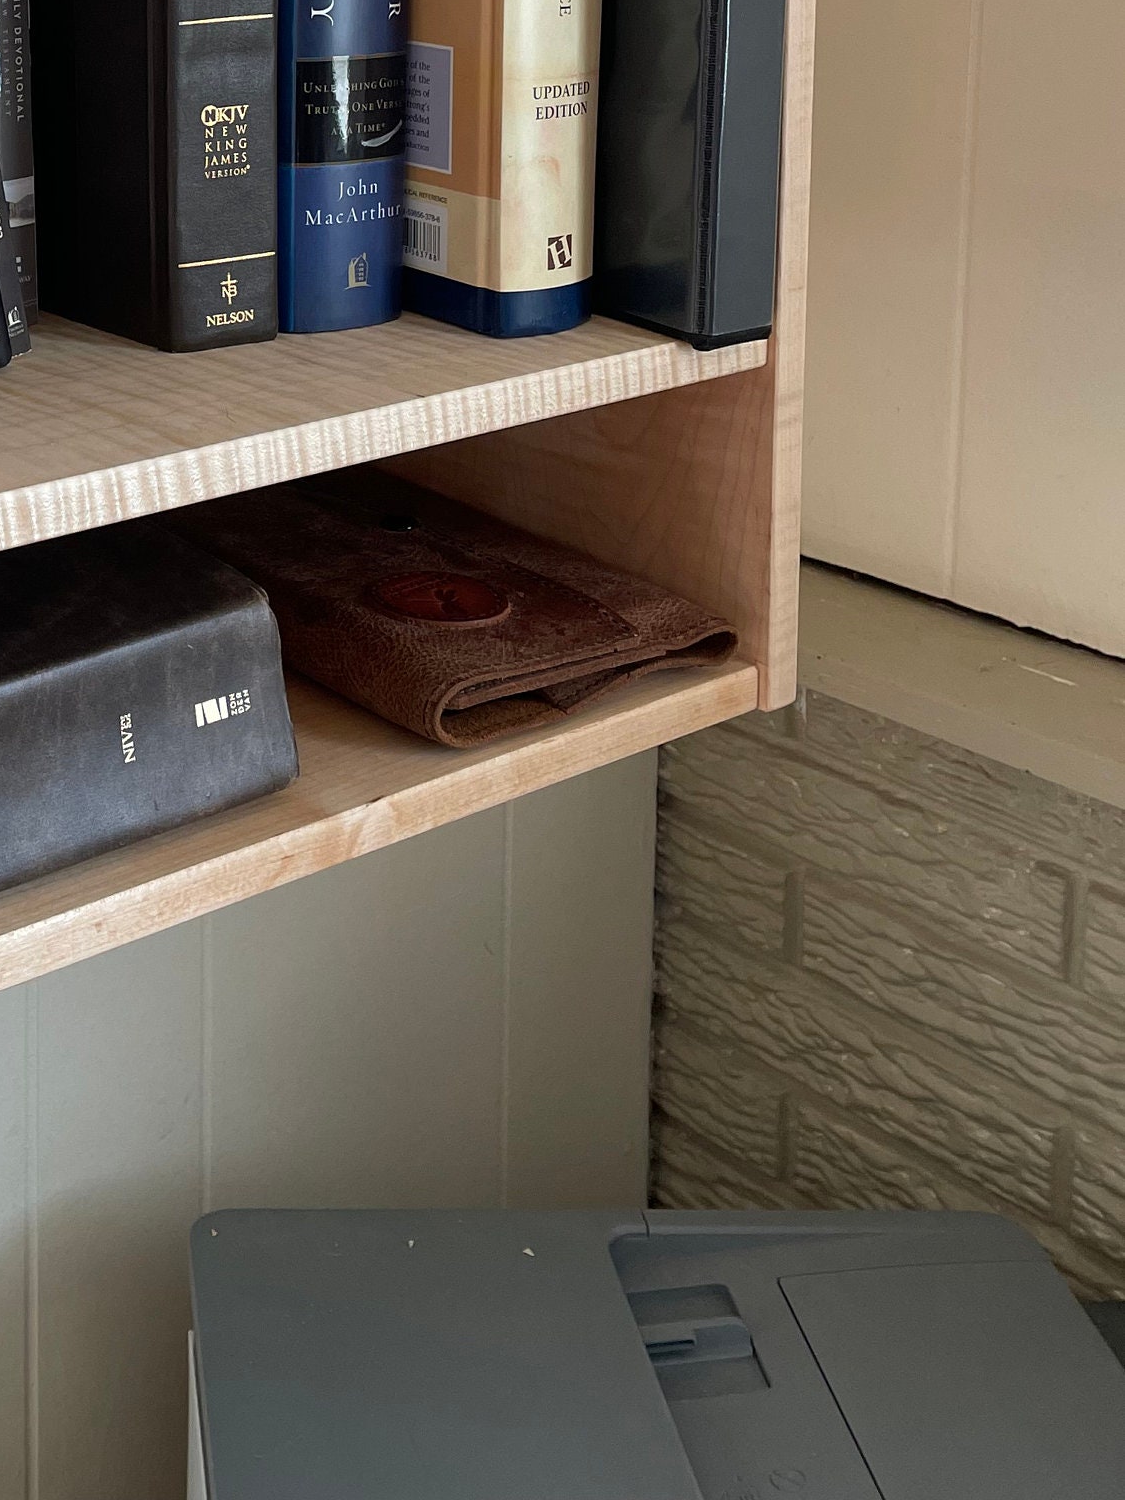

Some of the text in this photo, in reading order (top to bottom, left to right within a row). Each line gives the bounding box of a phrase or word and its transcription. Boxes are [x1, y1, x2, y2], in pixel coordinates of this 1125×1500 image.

[14, 27, 25, 122] DEVOTIONAL
[303, 80, 377, 94] UNLEHING
[533, 81, 590, 100] UPDATED
[200, 104, 249, 126] NKJV
[352, 101, 375, 112] ONE
[535, 101, 588, 120] EDITION
[204, 124, 248, 138] NEW
[204, 137, 248, 153] KING
[204, 152, 248, 169] JAMES
[338, 180, 379, 200] John
[305, 202, 401, 226] MacArthur
[206, 309, 254, 327] NELSON
[229, 693, 238, 716] ZON
[236, 692, 245, 714] DER
[242, 689, 251, 711] VAN
